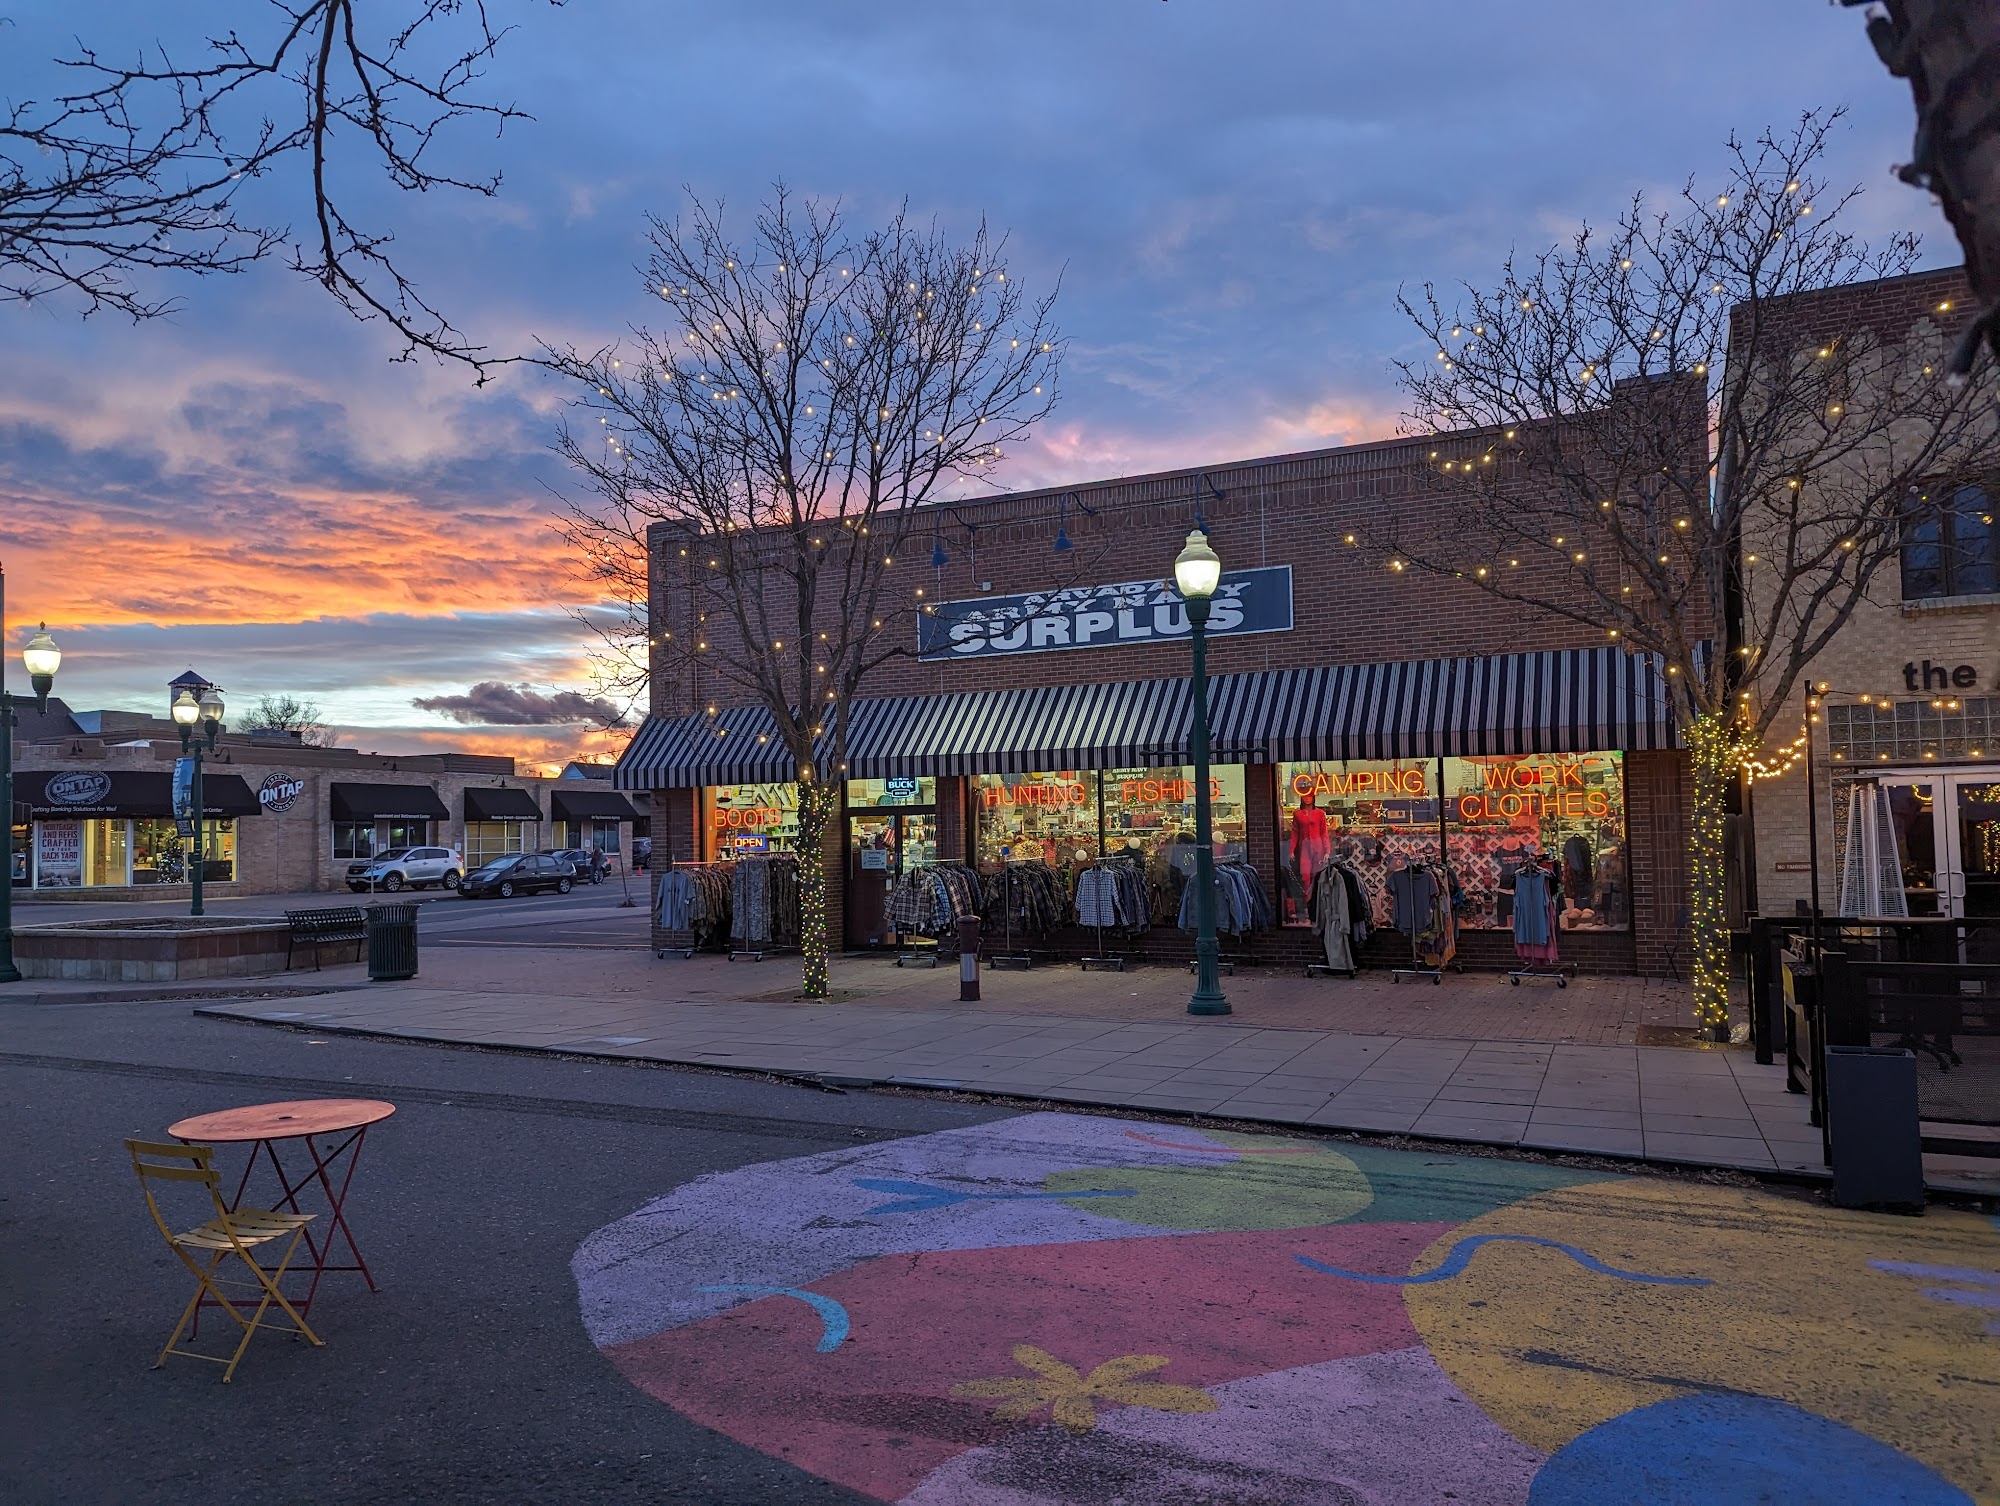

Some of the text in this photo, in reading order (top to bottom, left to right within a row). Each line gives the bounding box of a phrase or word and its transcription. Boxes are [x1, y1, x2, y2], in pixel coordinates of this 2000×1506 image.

[961, 581, 1251, 623] ARMY NAY
[1023, 581, 1176, 605] ARVADA
[949, 599, 1245, 652] SURPLUS
[1903, 660, 1976, 690] the
[1122, 776, 1220, 802] FISHING
[1293, 770, 1423, 796] CAMPING
[1482, 763, 1582, 790] WORK
[985, 783, 1085, 806] HUNTING
[1459, 792, 1608, 817] CLOTHES
[714, 807, 782, 828] BOOTS
[42, 839, 78, 847] CRAFTED
[735, 838, 763, 847] OPEN
